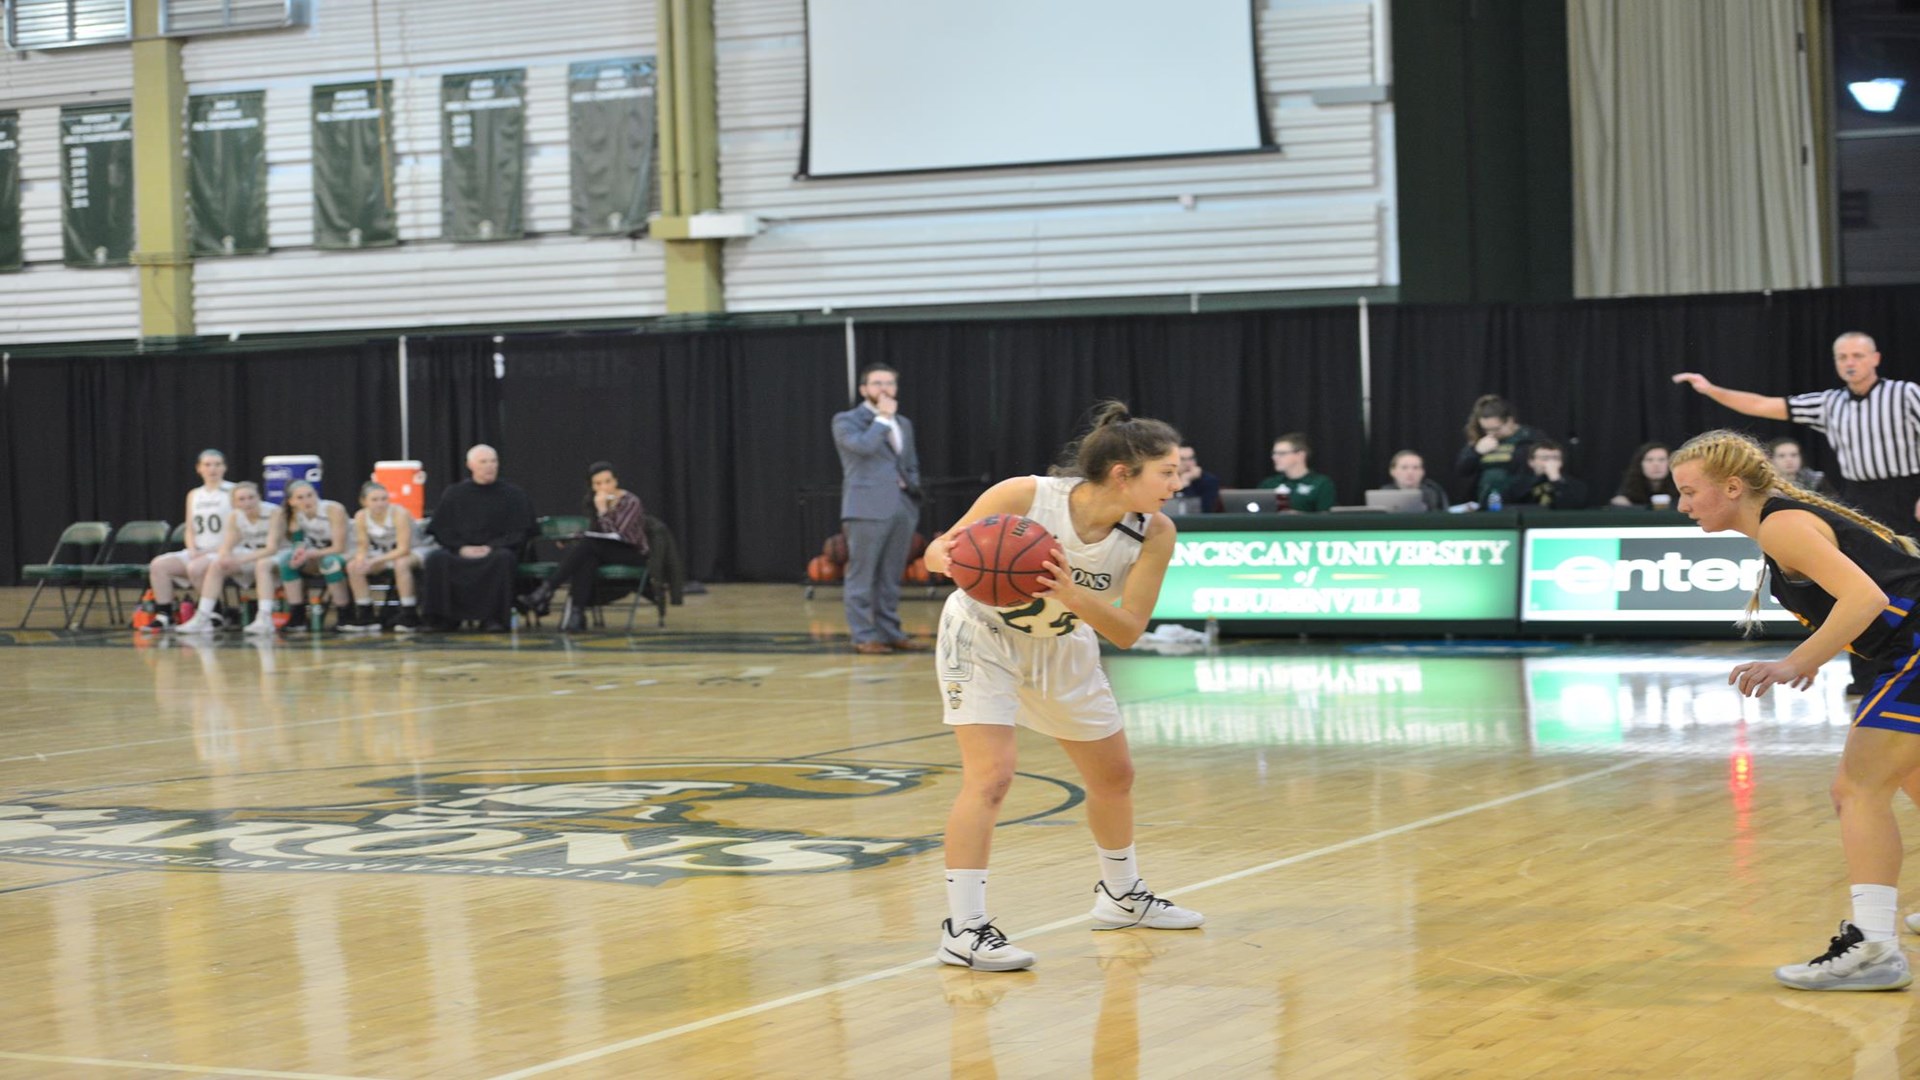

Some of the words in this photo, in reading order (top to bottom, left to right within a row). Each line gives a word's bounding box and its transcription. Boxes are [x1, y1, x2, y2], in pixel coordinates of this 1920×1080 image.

[1168, 541, 1312, 567] NCISCAN
[1315, 539, 1511, 567] UNIVERSITY
[1069, 567, 1112, 591] ONS
[1293, 566, 1320, 588] of
[1554, 552, 1771, 595] enter
[287, 862, 659, 881] UNIVERSITY
